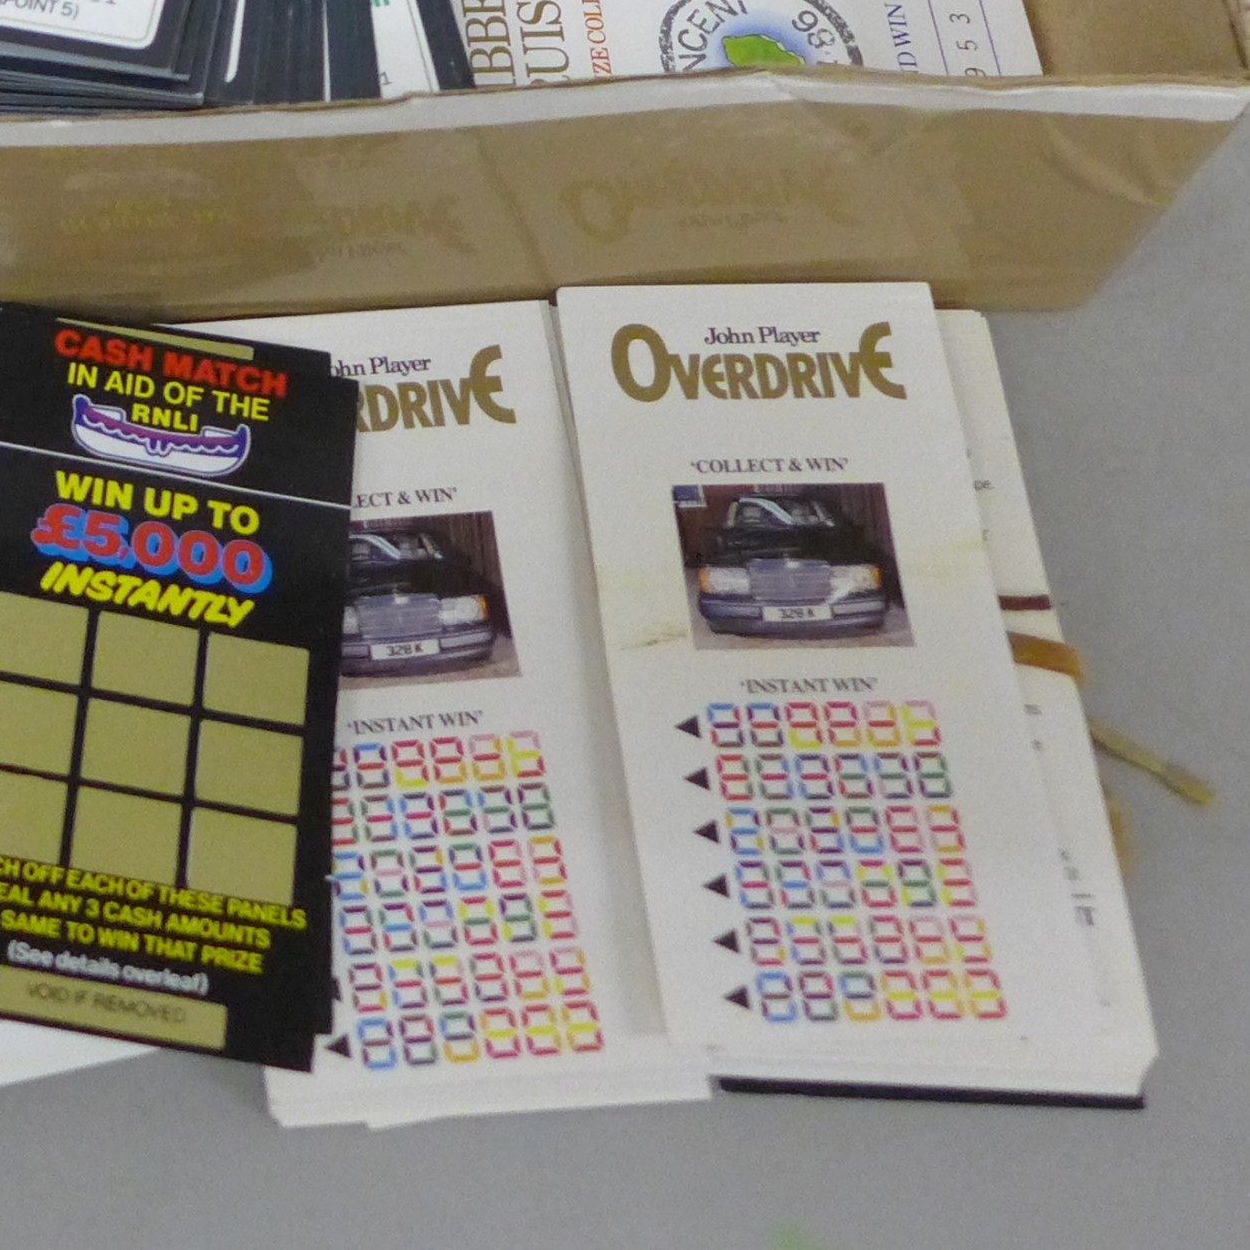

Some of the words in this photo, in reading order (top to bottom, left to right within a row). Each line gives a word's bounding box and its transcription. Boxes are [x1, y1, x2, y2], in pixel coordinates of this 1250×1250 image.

[53, 329, 154, 369] CASH
[163, 352, 288, 398] MATCH
[369, 356, 431, 377] Player
[611, 321, 907, 403] OVERDRIVE
[704, 327, 754, 345] John
[757, 326, 820, 347] Player
[67, 362, 98, 389] IN
[104, 371, 155, 399] AID
[163, 381, 204, 407] OF
[211, 390, 271, 421] THE
[131, 403, 199, 432] RNLI
[788, 459, 802, 472] &
[55, 470, 134, 510] WIN
[144, 487, 199, 520] UP
[207, 500, 261, 536] TO
[30, 503, 273, 594] £5,000
[40, 562, 255, 628] INSTANTLY
[0, 908, 61, 938] SAME
[65, 920, 95, 945] TO
[96, 924, 141, 952] WIN
[143, 933, 198, 961] THAT
[200, 944, 264, 975] PRIZE
